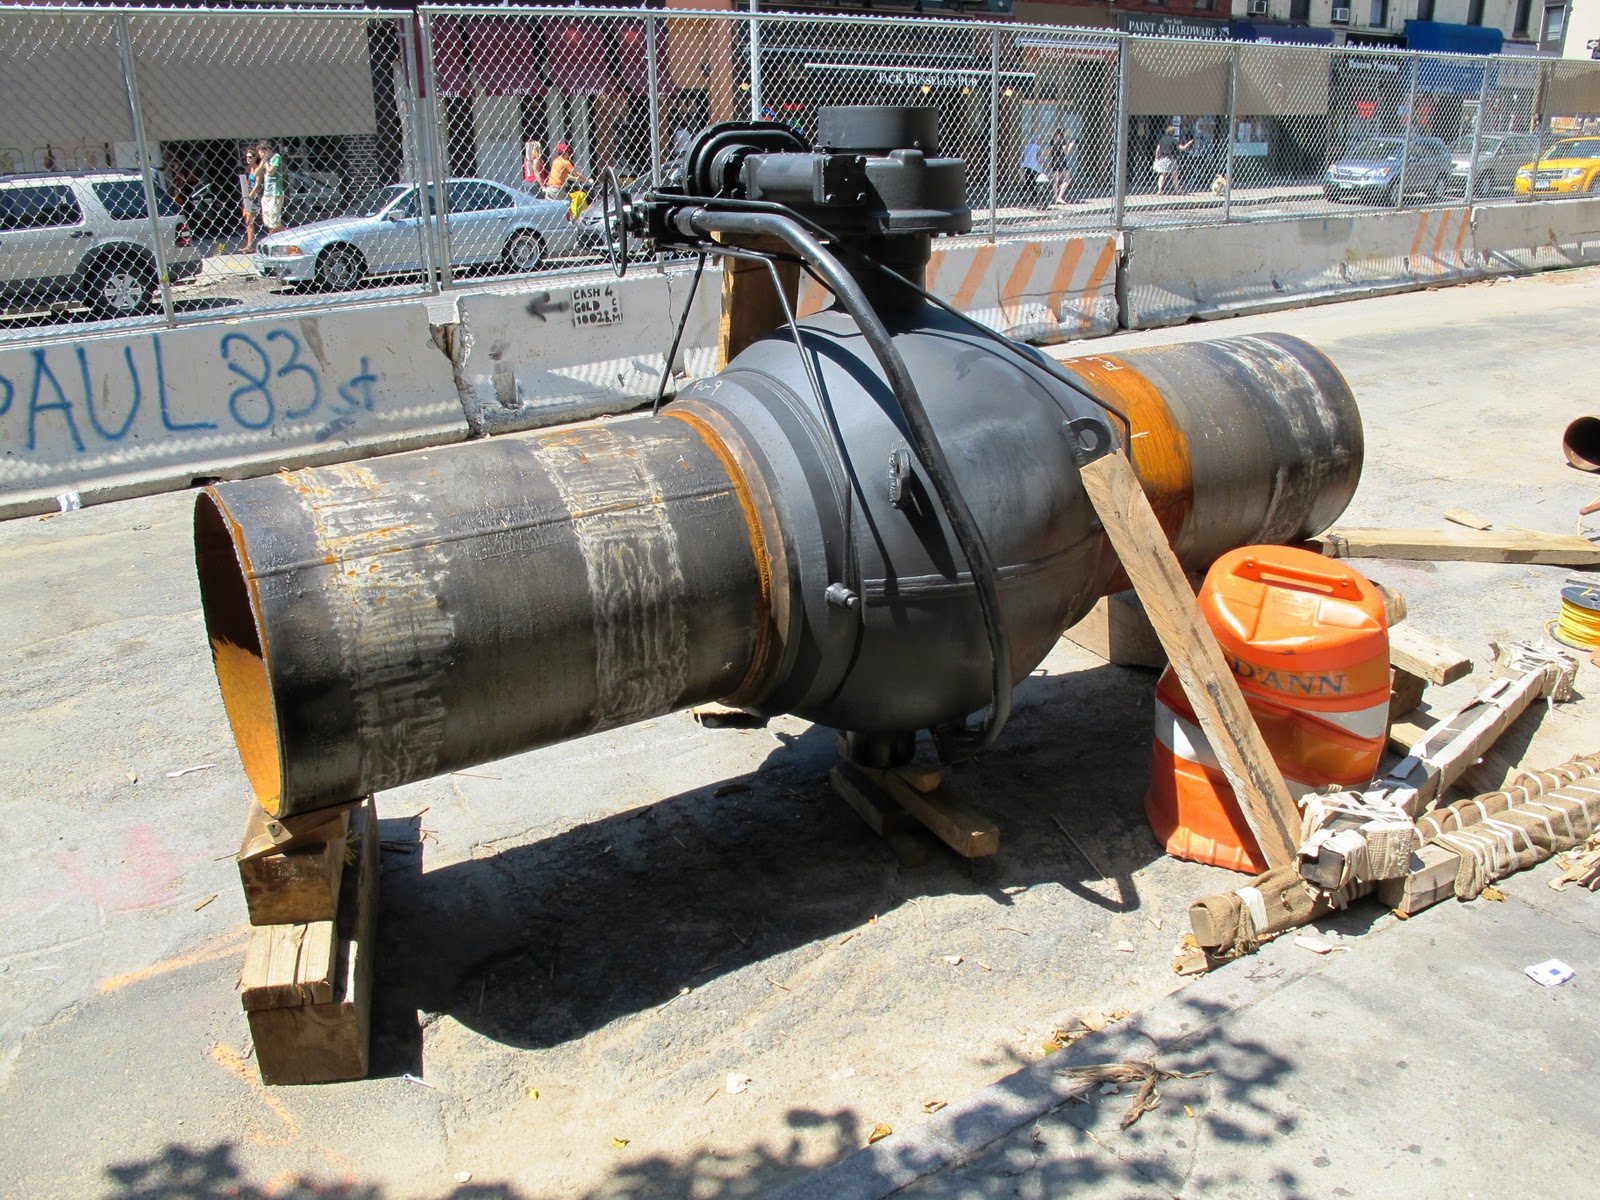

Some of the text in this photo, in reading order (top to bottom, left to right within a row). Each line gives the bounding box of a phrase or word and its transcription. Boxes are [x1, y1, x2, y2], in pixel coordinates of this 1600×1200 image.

[1128, 21, 1217, 38] PAINT & HARDWARE
[877, 72, 904, 84] JACK
[573, 286, 614, 300] CASH 4
[574, 300, 601, 314] GOLD
[220, 328, 321, 430] 83
[1232, 655, 1347, 696] D'ANN
